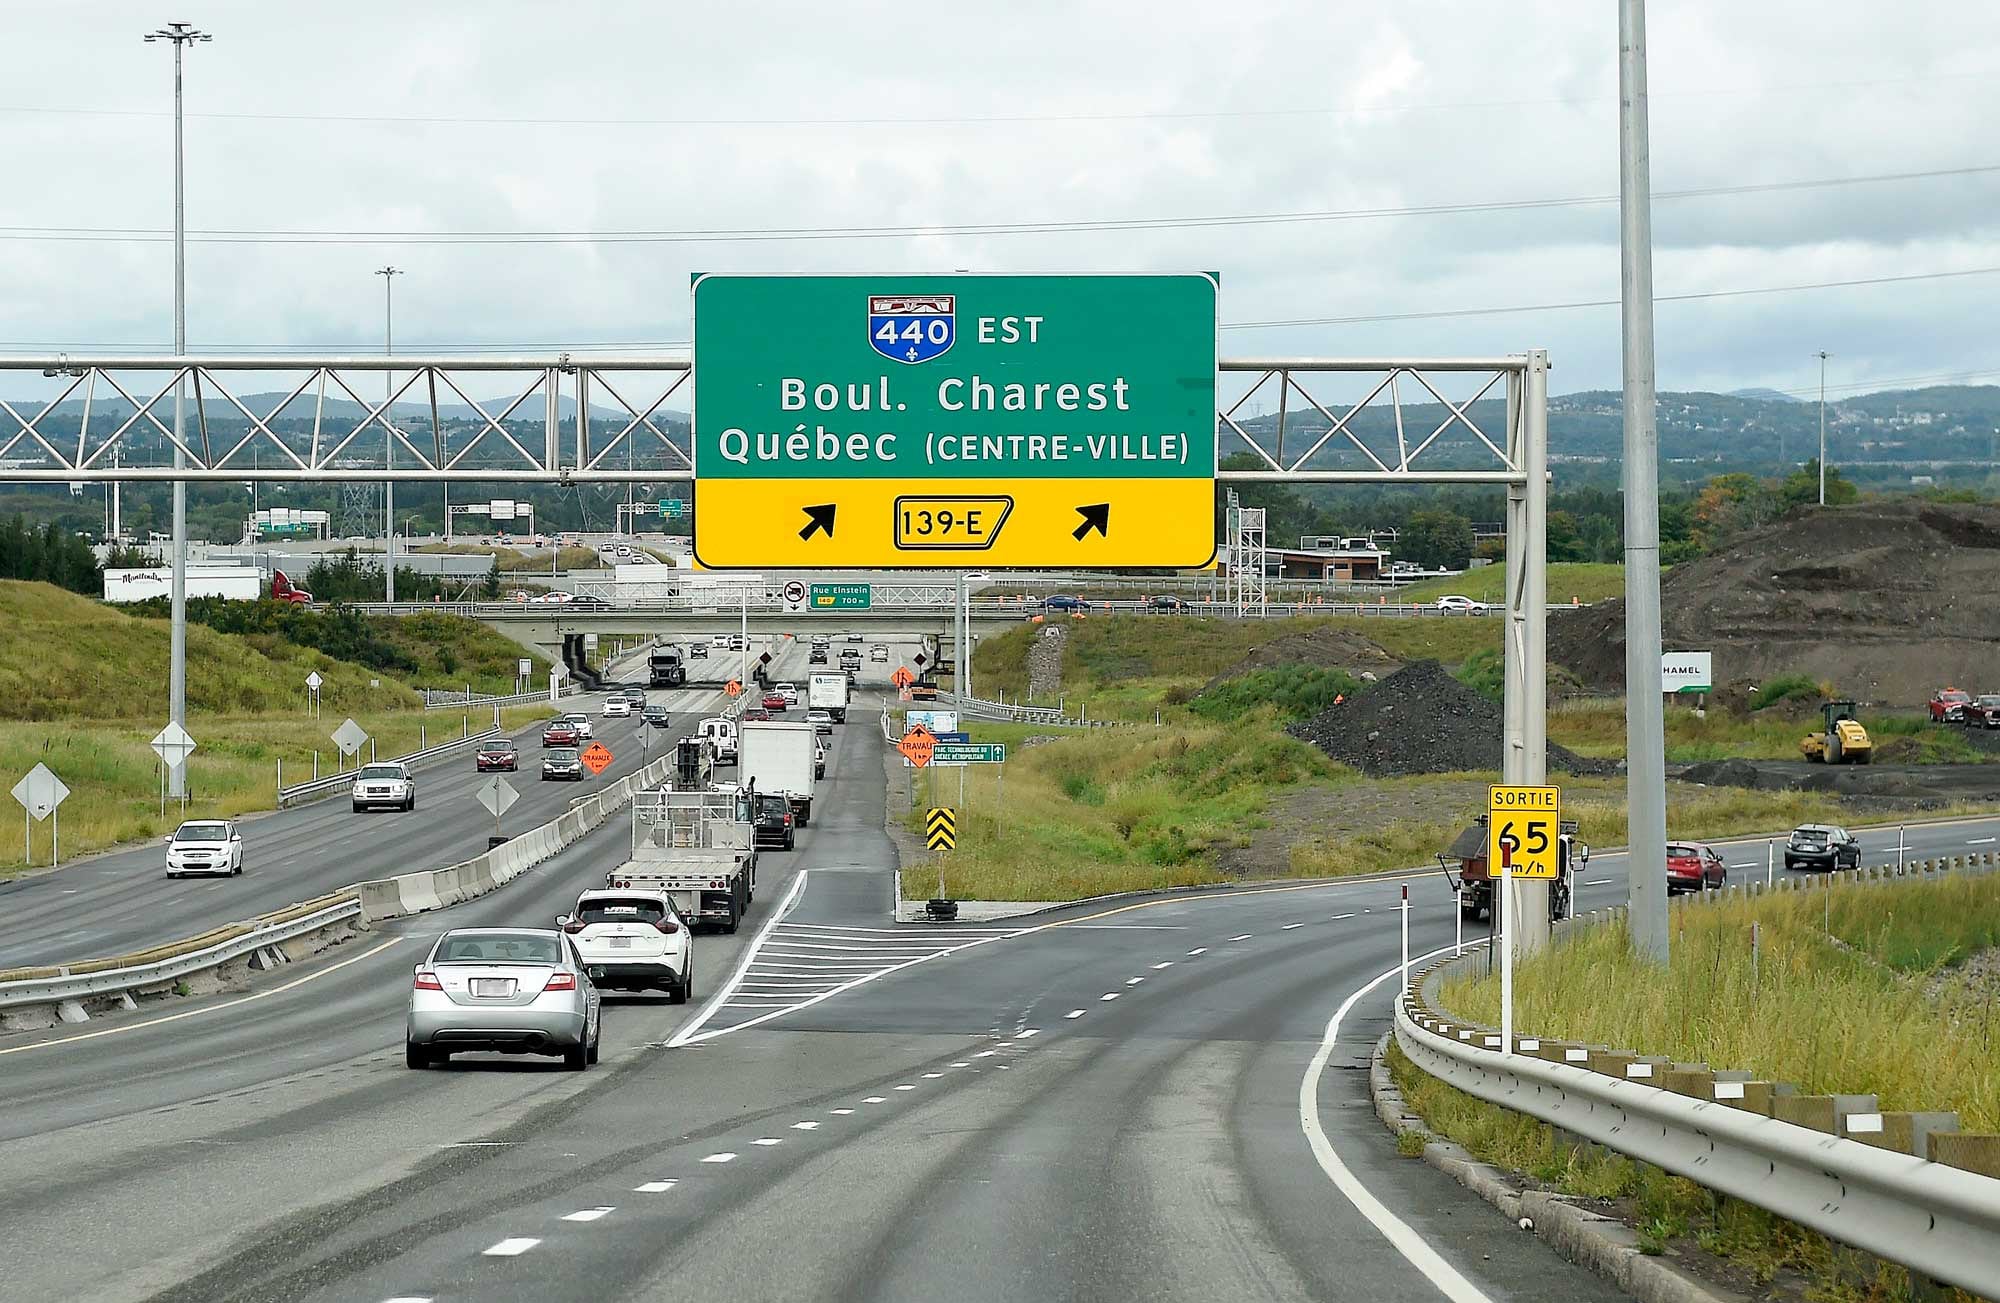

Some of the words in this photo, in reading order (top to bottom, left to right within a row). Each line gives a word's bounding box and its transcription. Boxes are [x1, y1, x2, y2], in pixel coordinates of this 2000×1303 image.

[875, 319, 949, 345] 440
[978, 316, 1044, 344] EST
[780, 376, 907, 412] Boul.
[937, 376, 1130, 412] Charest
[718, 426, 898, 466] Québec
[925, 432, 1189, 465] (CENTRE-VILLE)
[902, 511, 982, 536] 139-E
[833, 586, 868, 594] Einstein
[1663, 666, 1701, 674] HAMEL
[902, 742, 933, 750] TRAVAU
[1495, 792, 1554, 805] SORTIE
[1498, 821, 1549, 854] 65
[1508, 860, 1545, 875] m/h
